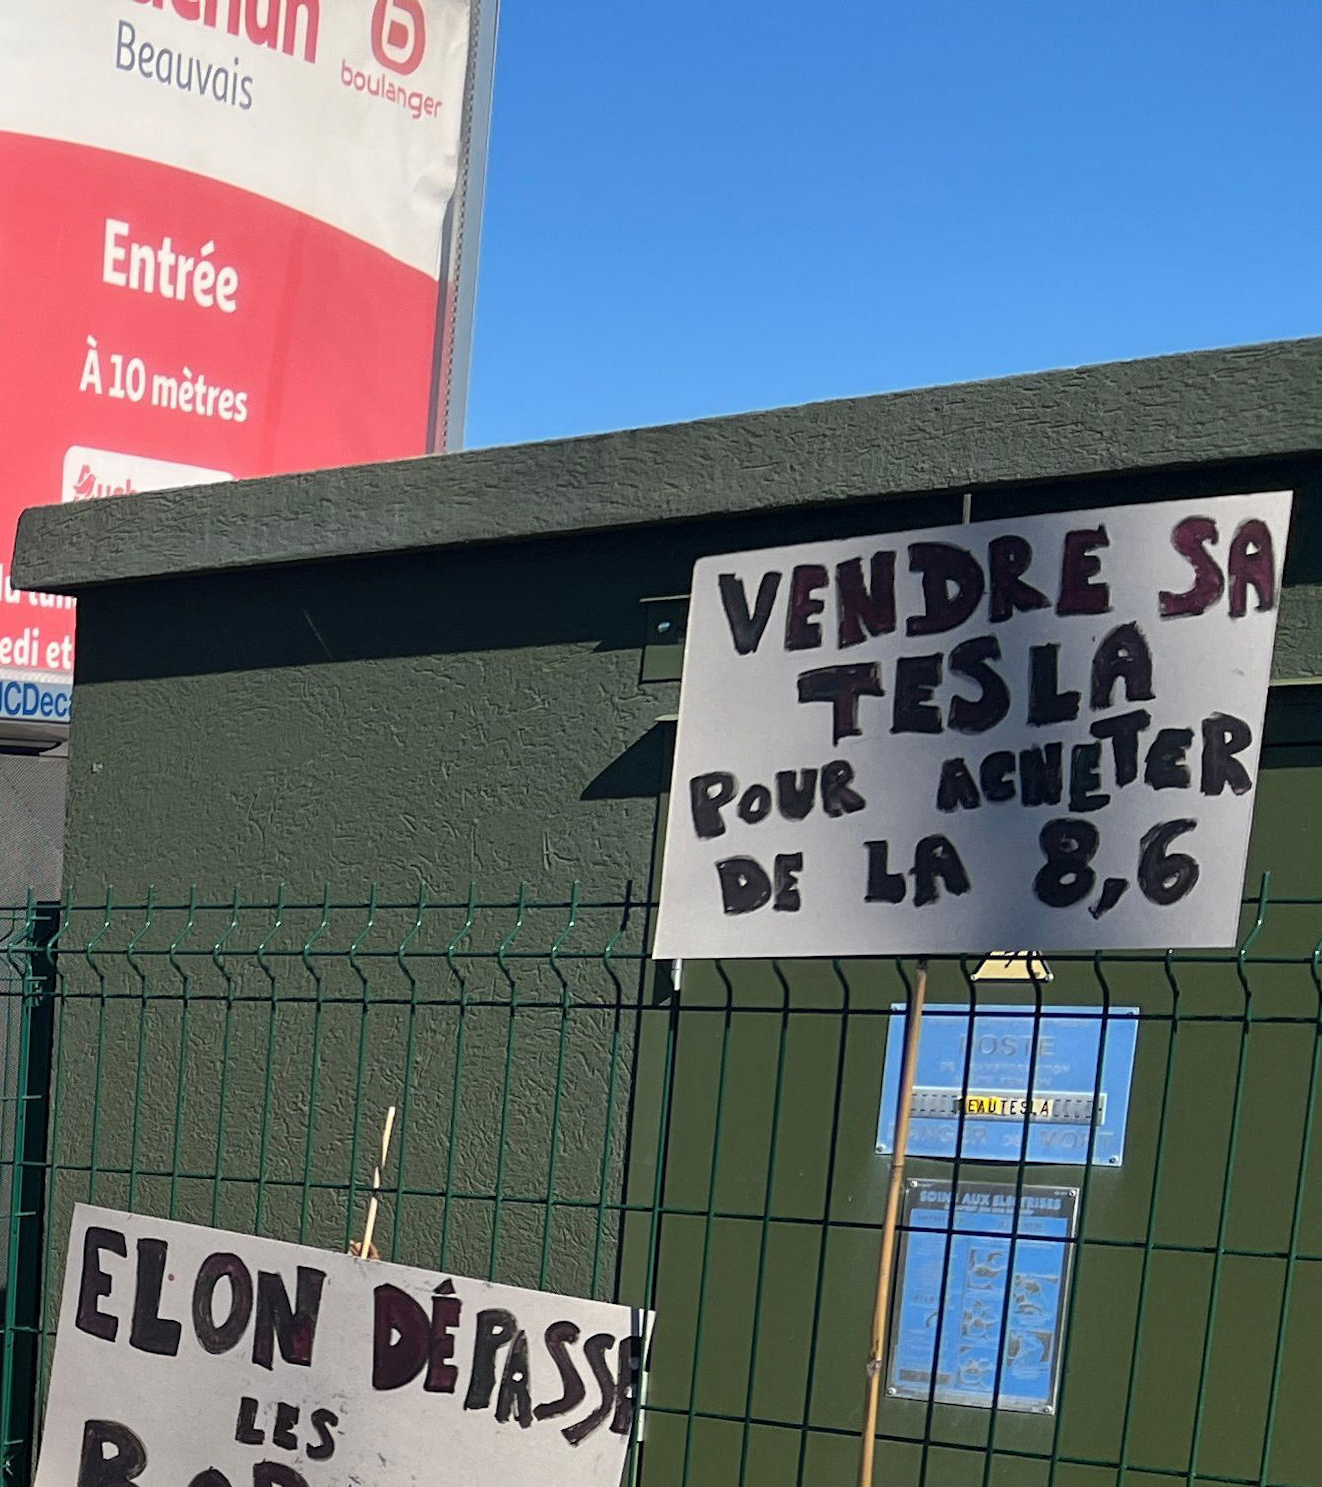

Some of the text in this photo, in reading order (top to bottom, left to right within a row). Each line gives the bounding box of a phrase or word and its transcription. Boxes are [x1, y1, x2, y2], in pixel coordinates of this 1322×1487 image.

[116, 20, 254, 110] Beauvais
[340, 58, 442, 119] boulanger
[103, 217, 239, 314] Entrée
[79, 334, 248, 423] À 10 mètres
[718, 516, 1276, 656] VENDRE SA
[45, 635, 73, 671] et
[796, 621, 1157, 747] TESLA
[689, 709, 1253, 839] POUR ACHETER
[714, 818, 1200, 920] DE LA 8,6
[75, 1225, 328, 1371] ELON
[235, 1397, 339, 1460] LES
